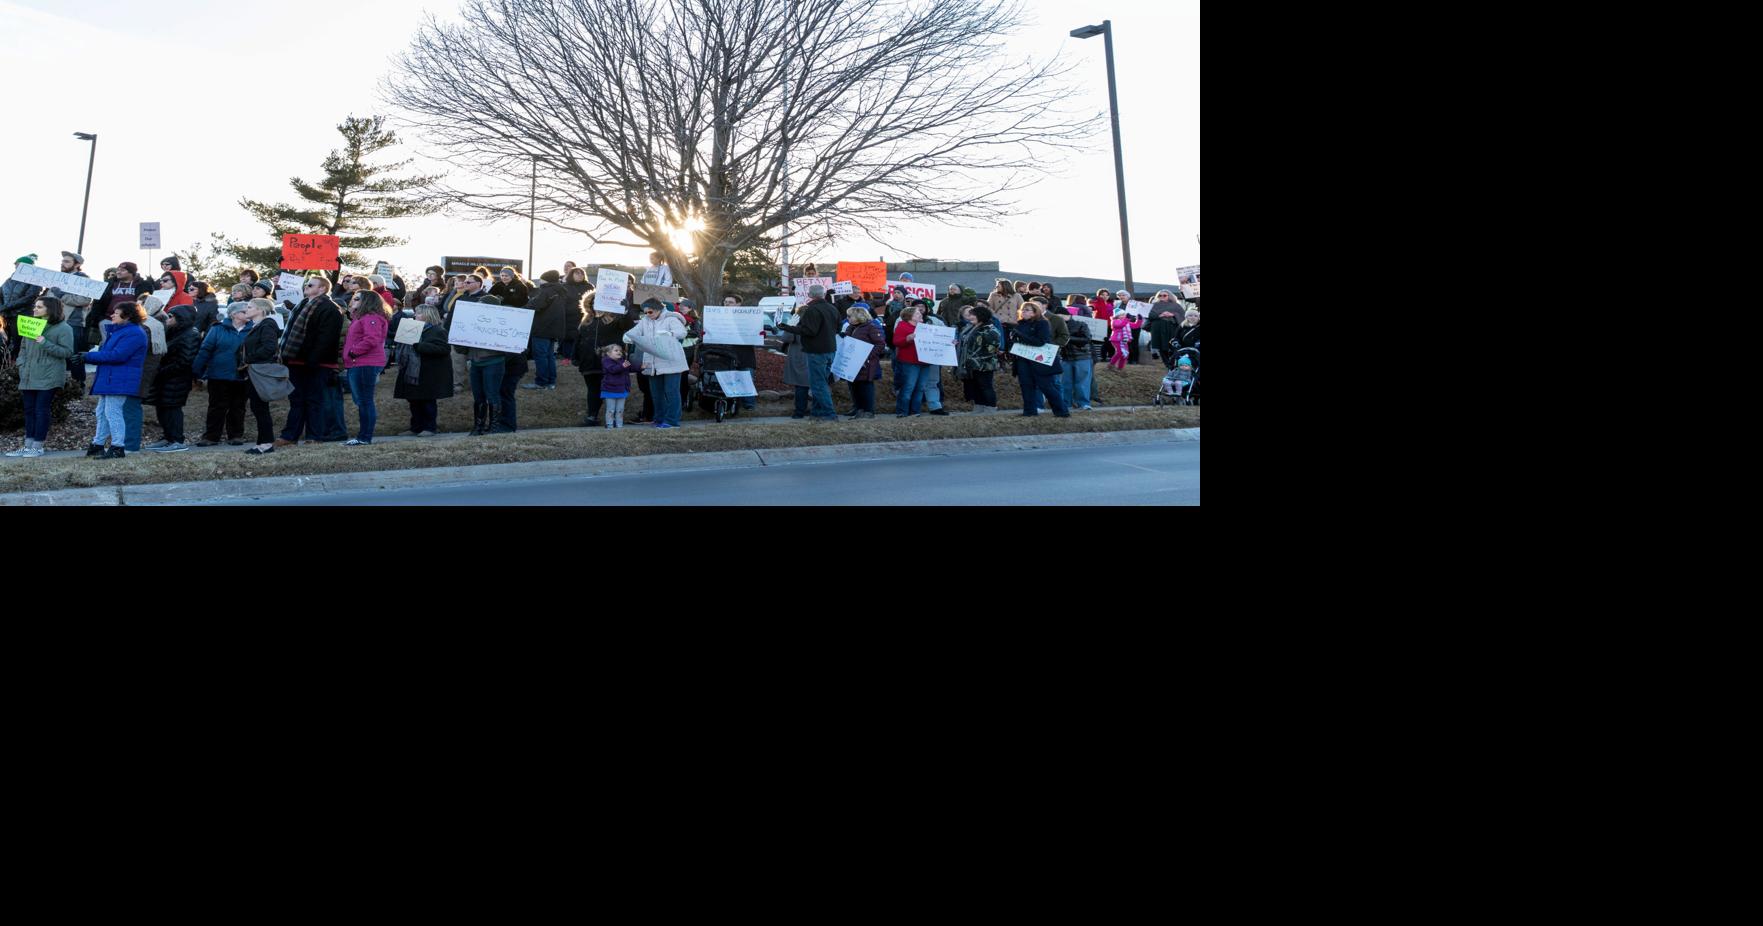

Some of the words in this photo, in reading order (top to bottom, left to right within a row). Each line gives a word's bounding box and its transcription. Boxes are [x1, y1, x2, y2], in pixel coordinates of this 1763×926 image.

[289, 237, 322, 254] People
[888, 285, 933, 299] RSIGN
[26, 319, 41, 327] Party
